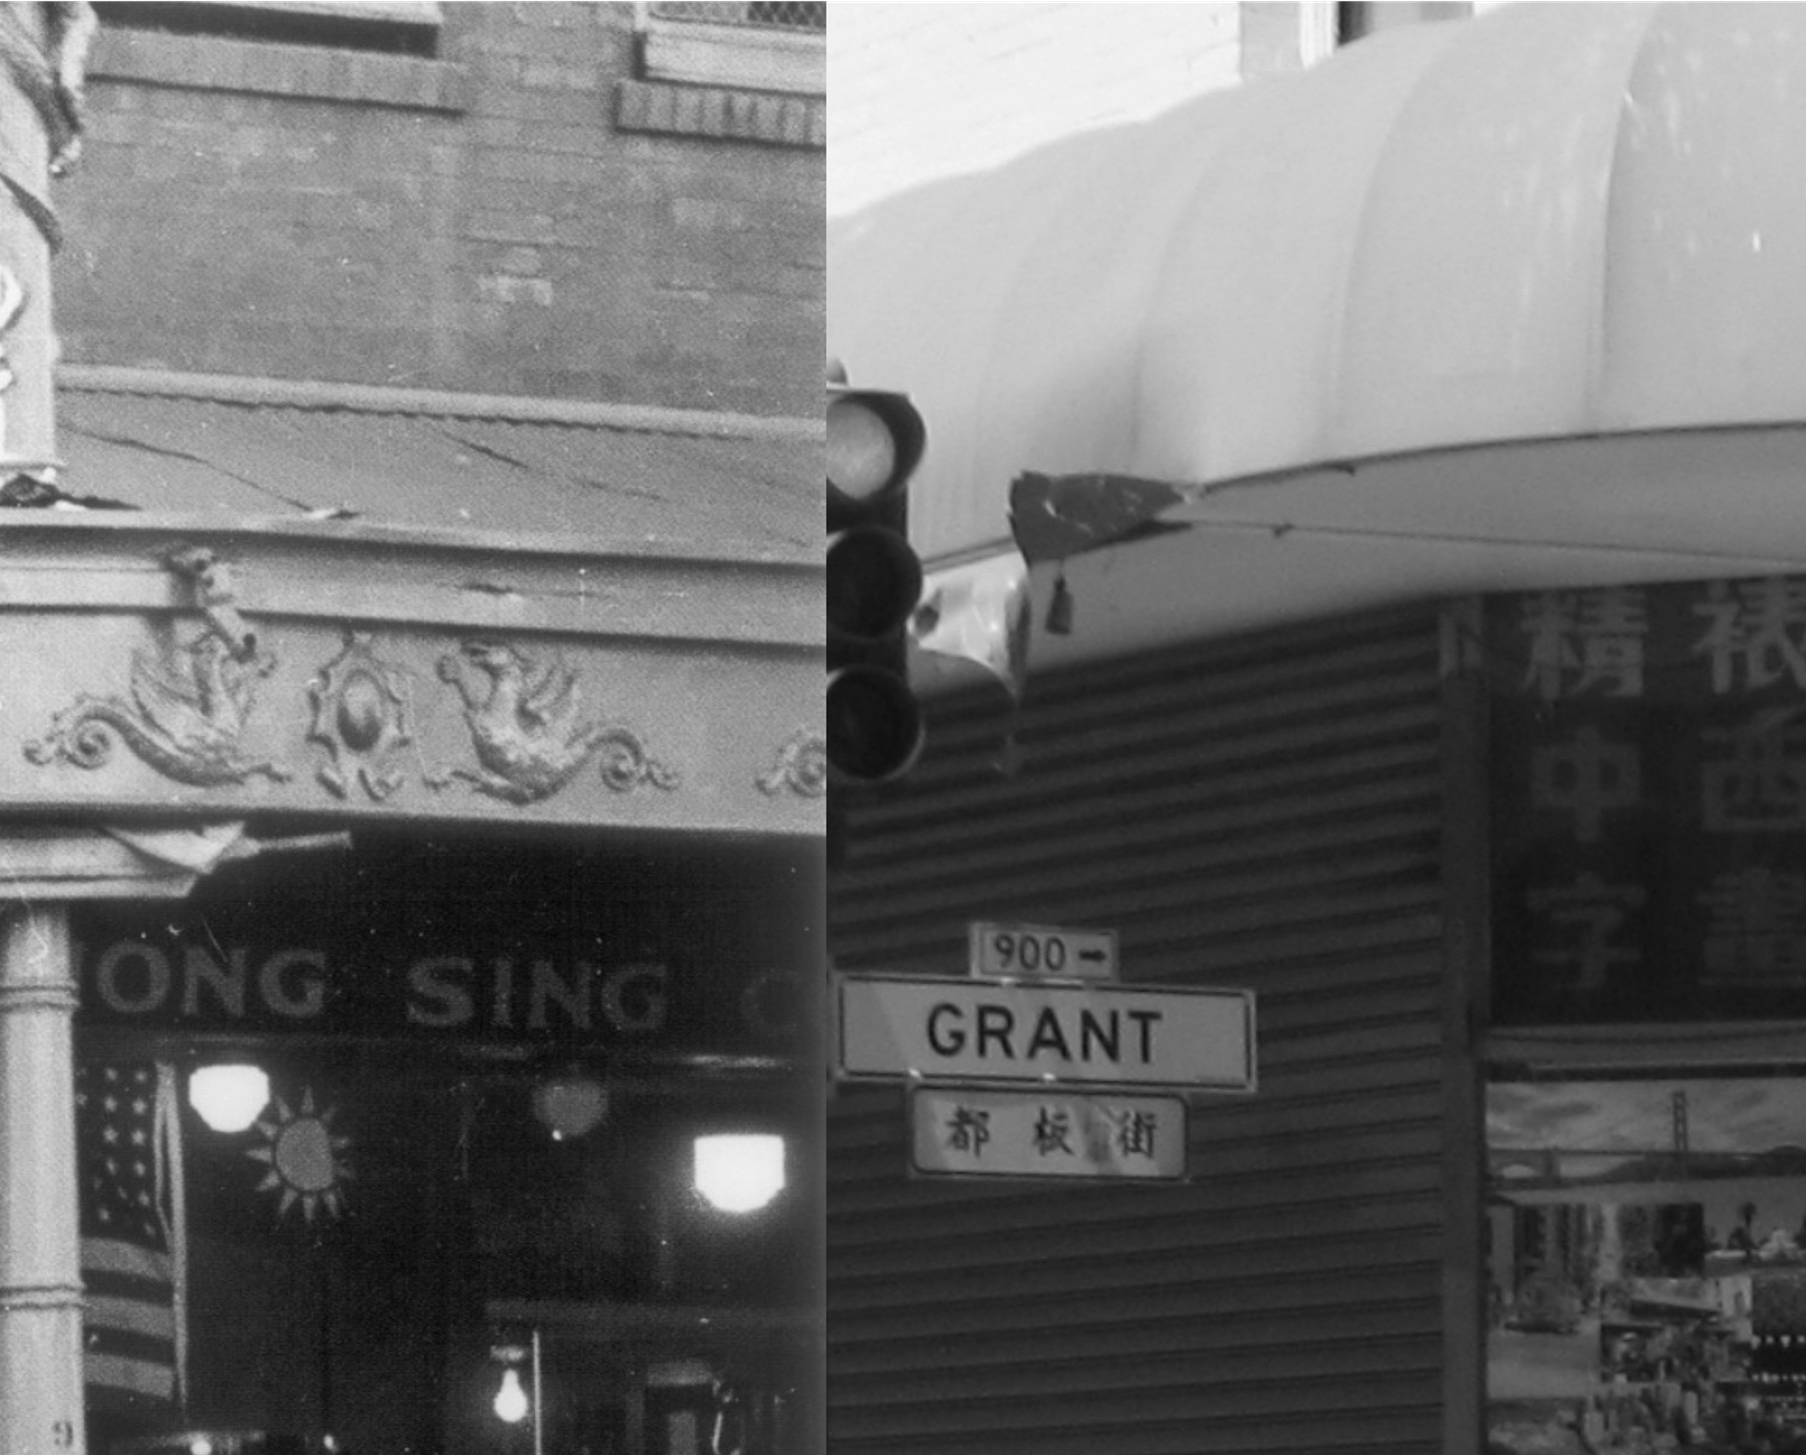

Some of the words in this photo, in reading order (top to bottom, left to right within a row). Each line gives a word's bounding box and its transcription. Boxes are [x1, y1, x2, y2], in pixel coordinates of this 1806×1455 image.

[993, 934, 1067, 973] 900
[406, 955, 669, 1032] SING
[926, 1003, 1163, 1065] GRANT
[944, 1107, 1158, 1158] 都板街
